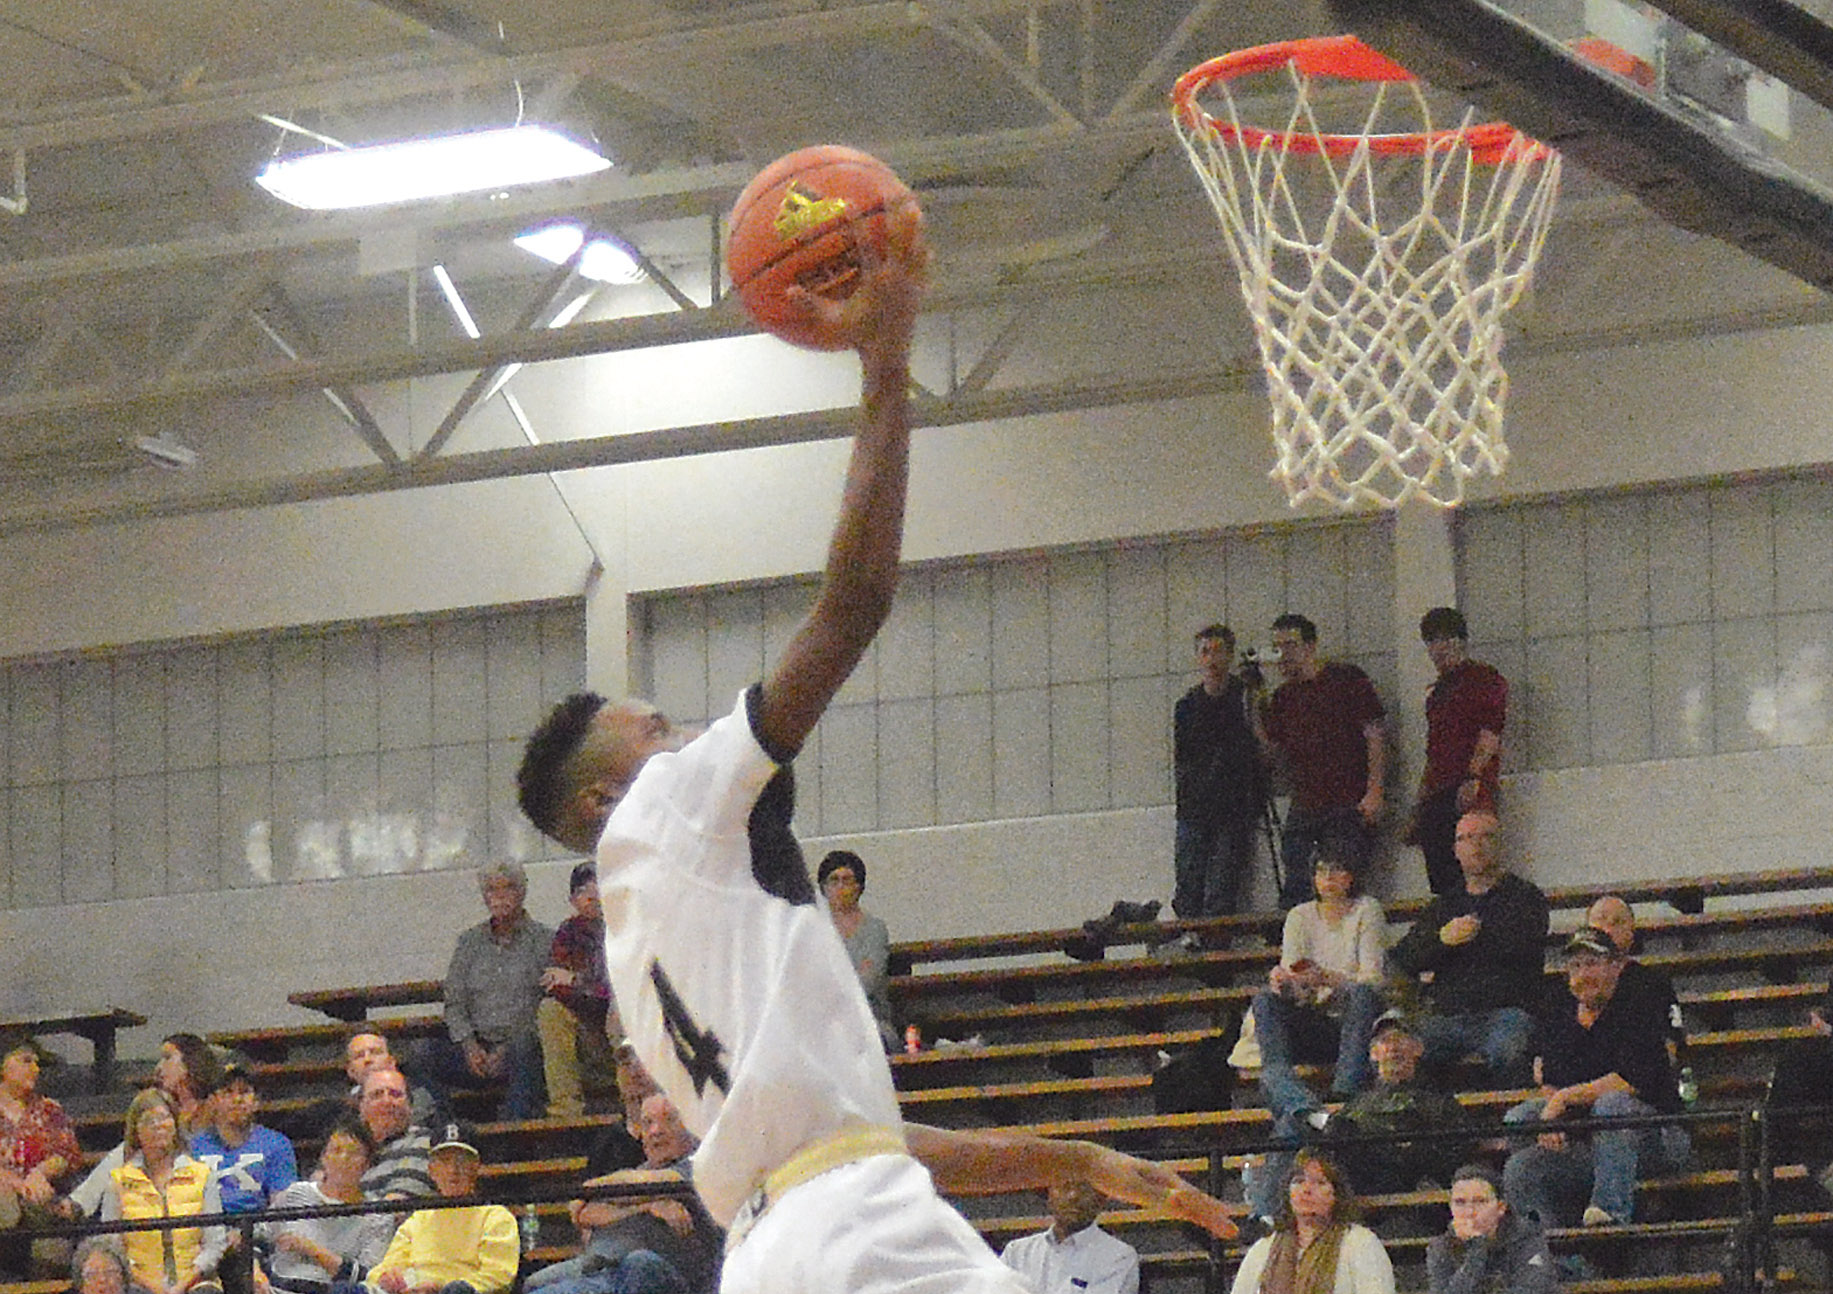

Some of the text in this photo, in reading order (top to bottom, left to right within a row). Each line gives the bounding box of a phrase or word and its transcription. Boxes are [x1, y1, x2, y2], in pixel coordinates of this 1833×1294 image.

[651, 957, 732, 1100] 4
[445, 1123, 460, 1141] B
[200, 1153, 263, 1191] K
